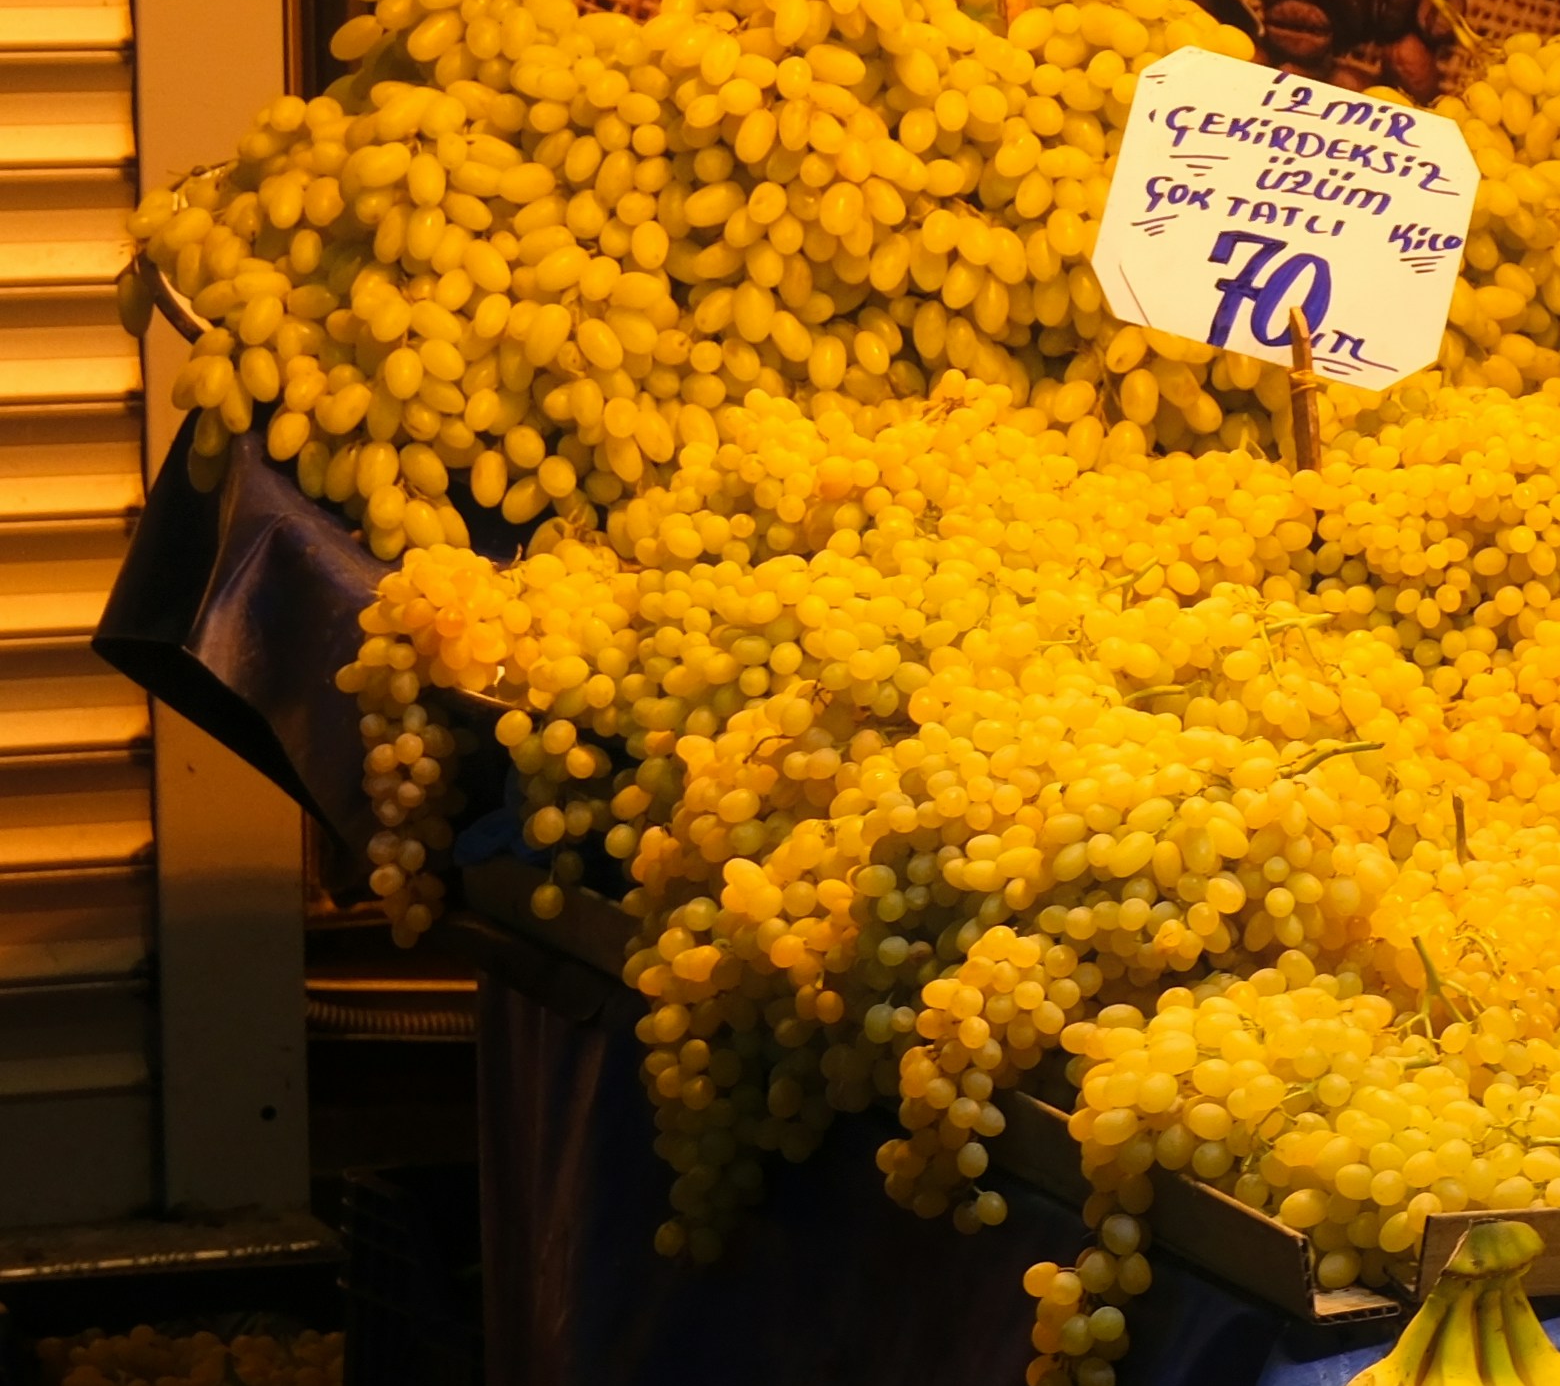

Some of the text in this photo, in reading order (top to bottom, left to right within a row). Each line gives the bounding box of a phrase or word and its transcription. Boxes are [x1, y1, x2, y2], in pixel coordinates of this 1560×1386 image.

[1164, 105, 1461, 196] ÇEKİRDEKSİZ
[1255, 156, 1392, 215] ÜZÜM
[1145, 175, 1346, 236] ÇOK TATLI
[1207, 229, 1332, 348] 70
